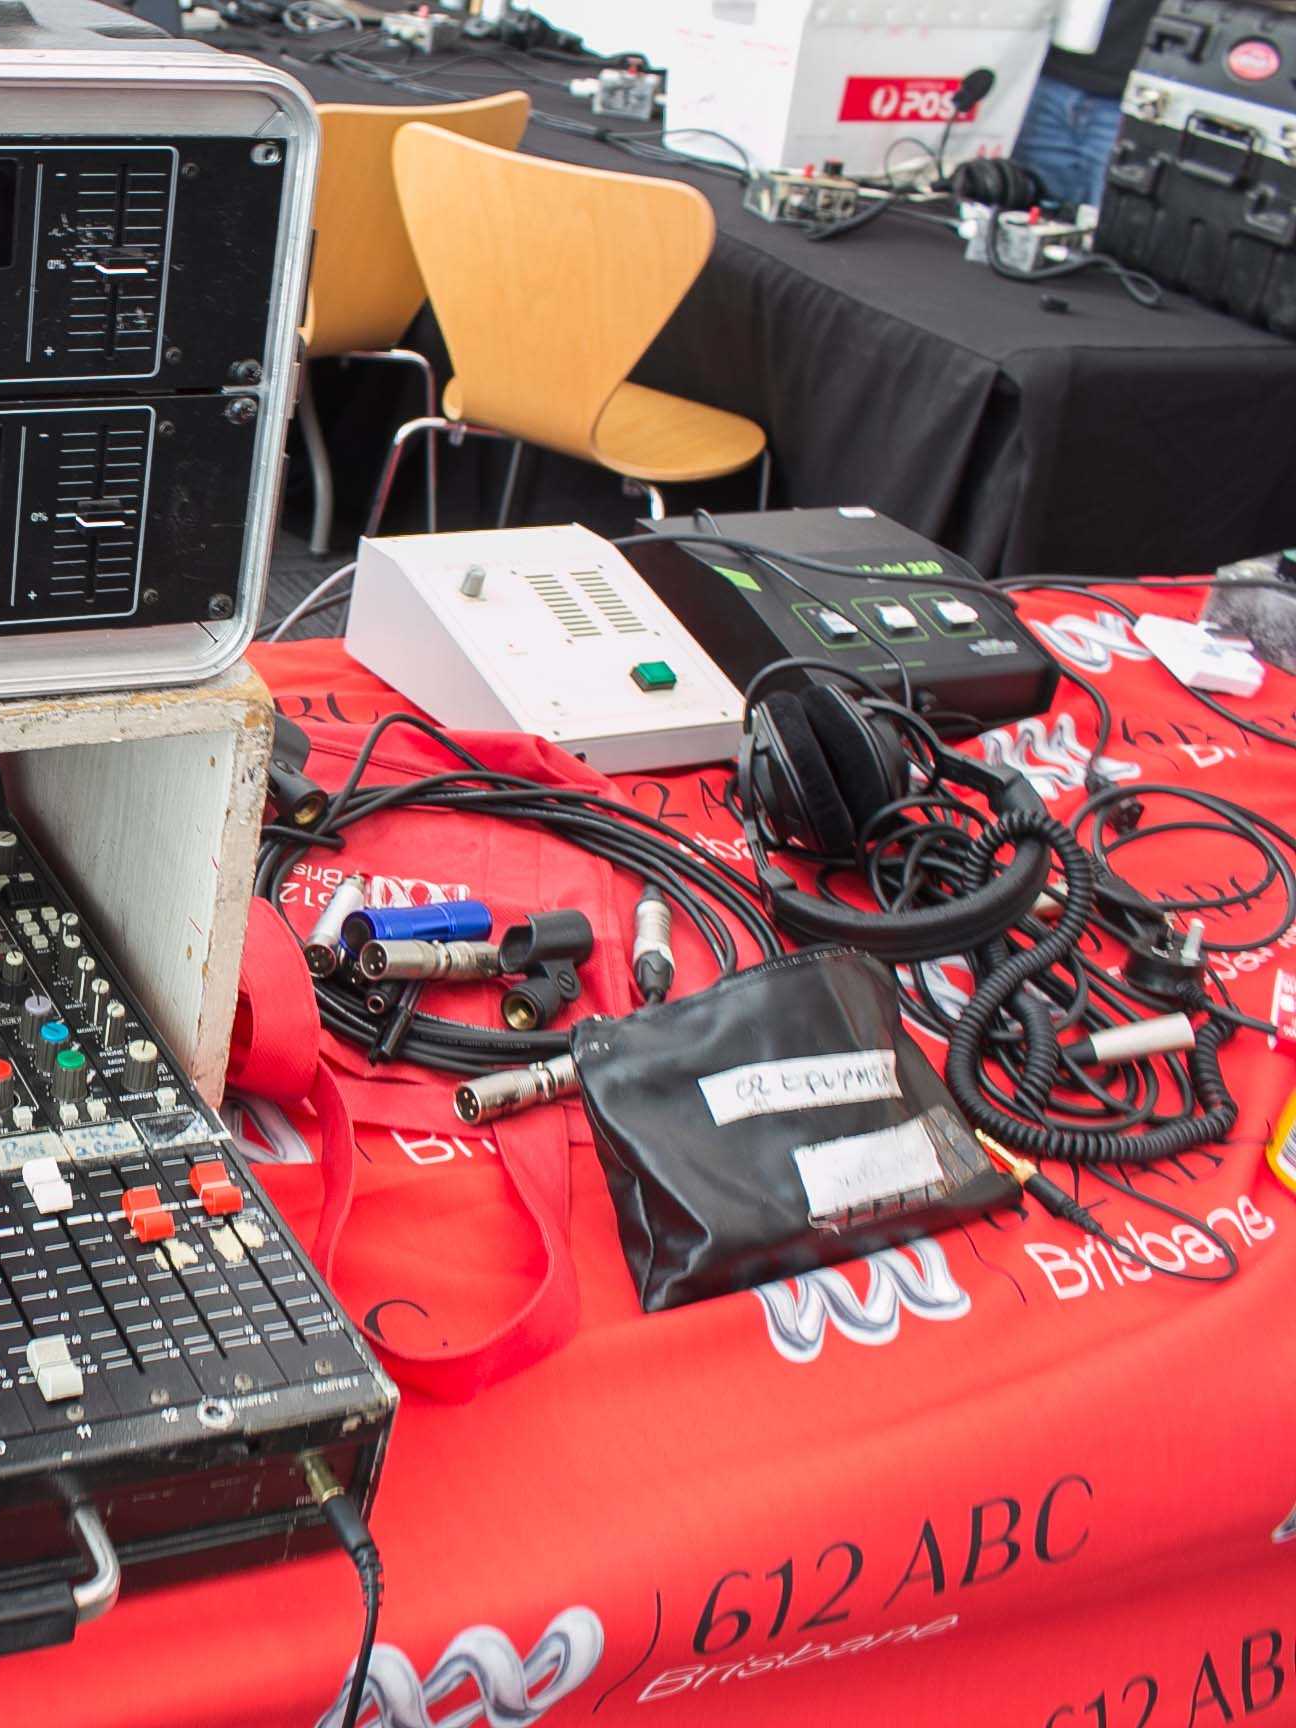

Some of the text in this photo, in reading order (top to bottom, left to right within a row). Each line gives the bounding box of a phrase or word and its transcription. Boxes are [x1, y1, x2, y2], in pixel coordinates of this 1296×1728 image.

[1023, 1194, 1276, 1300] Brisbane
[691, 1474, 1094, 1657] 612 ABC
[637, 1613, 959, 1703] Brisbane
[1187, 1628, 1296, 1728] AB
